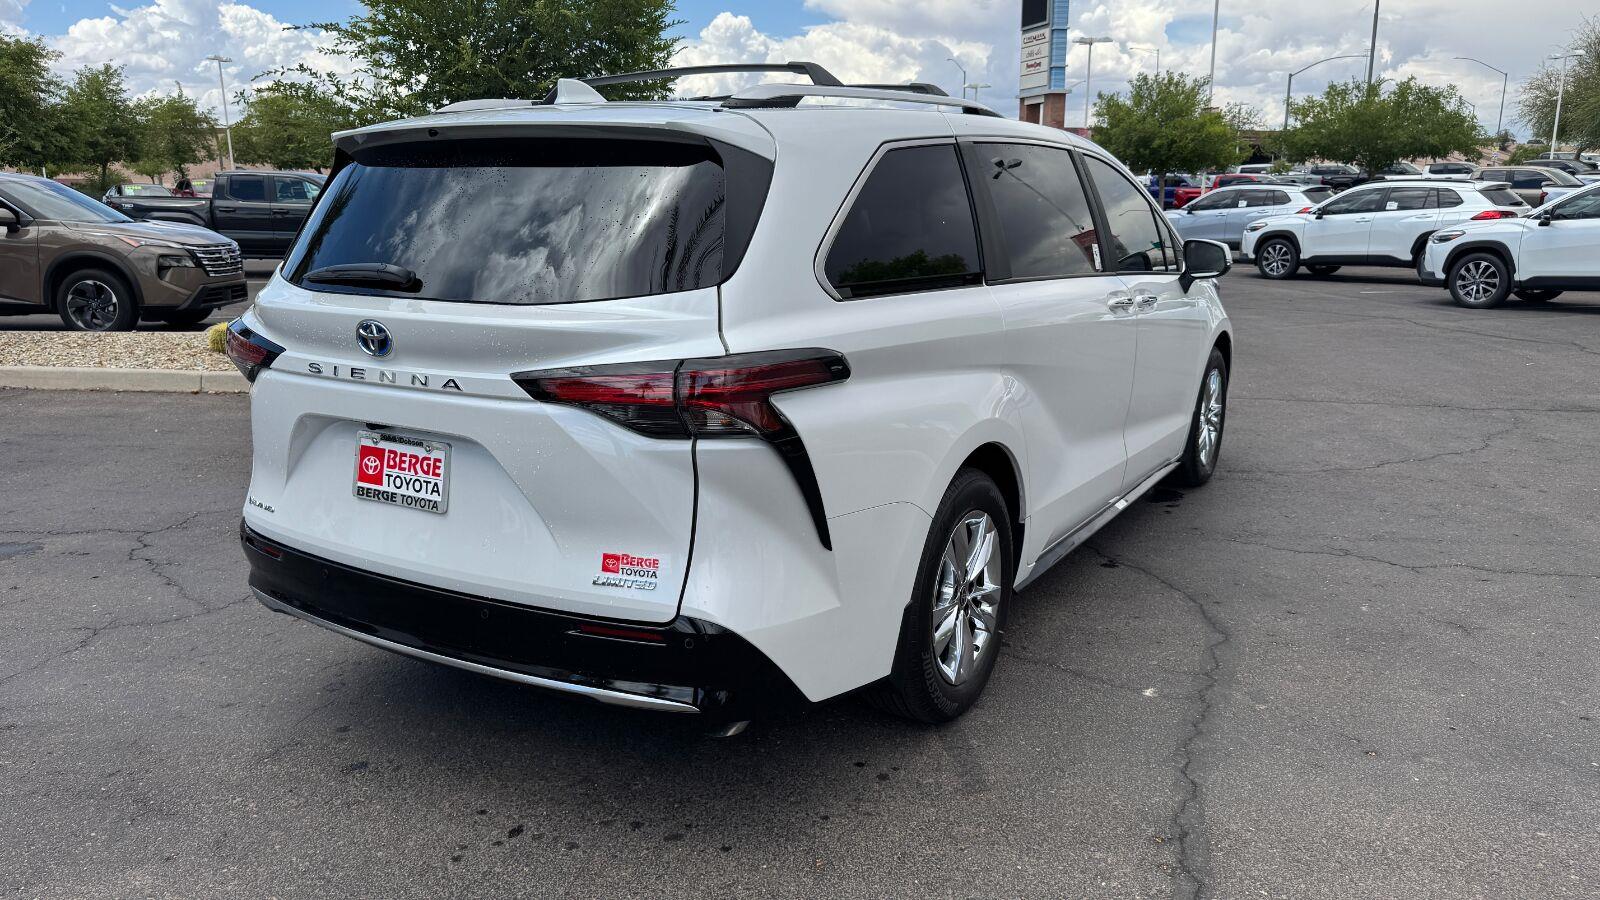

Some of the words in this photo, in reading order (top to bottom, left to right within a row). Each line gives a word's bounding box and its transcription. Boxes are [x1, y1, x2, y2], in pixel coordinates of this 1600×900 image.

[308, 362, 464, 391] SIENNA
[386, 449, 442, 477] BERGE
[385, 474, 440, 496] TOYOTA
[357, 486, 397, 502] BERGE
[400, 494, 438, 511] TOYOTA
[620, 553, 659, 568] BERGE
[620, 567, 658, 578] TOYOTA
[592, 575, 657, 590] LIMITED
